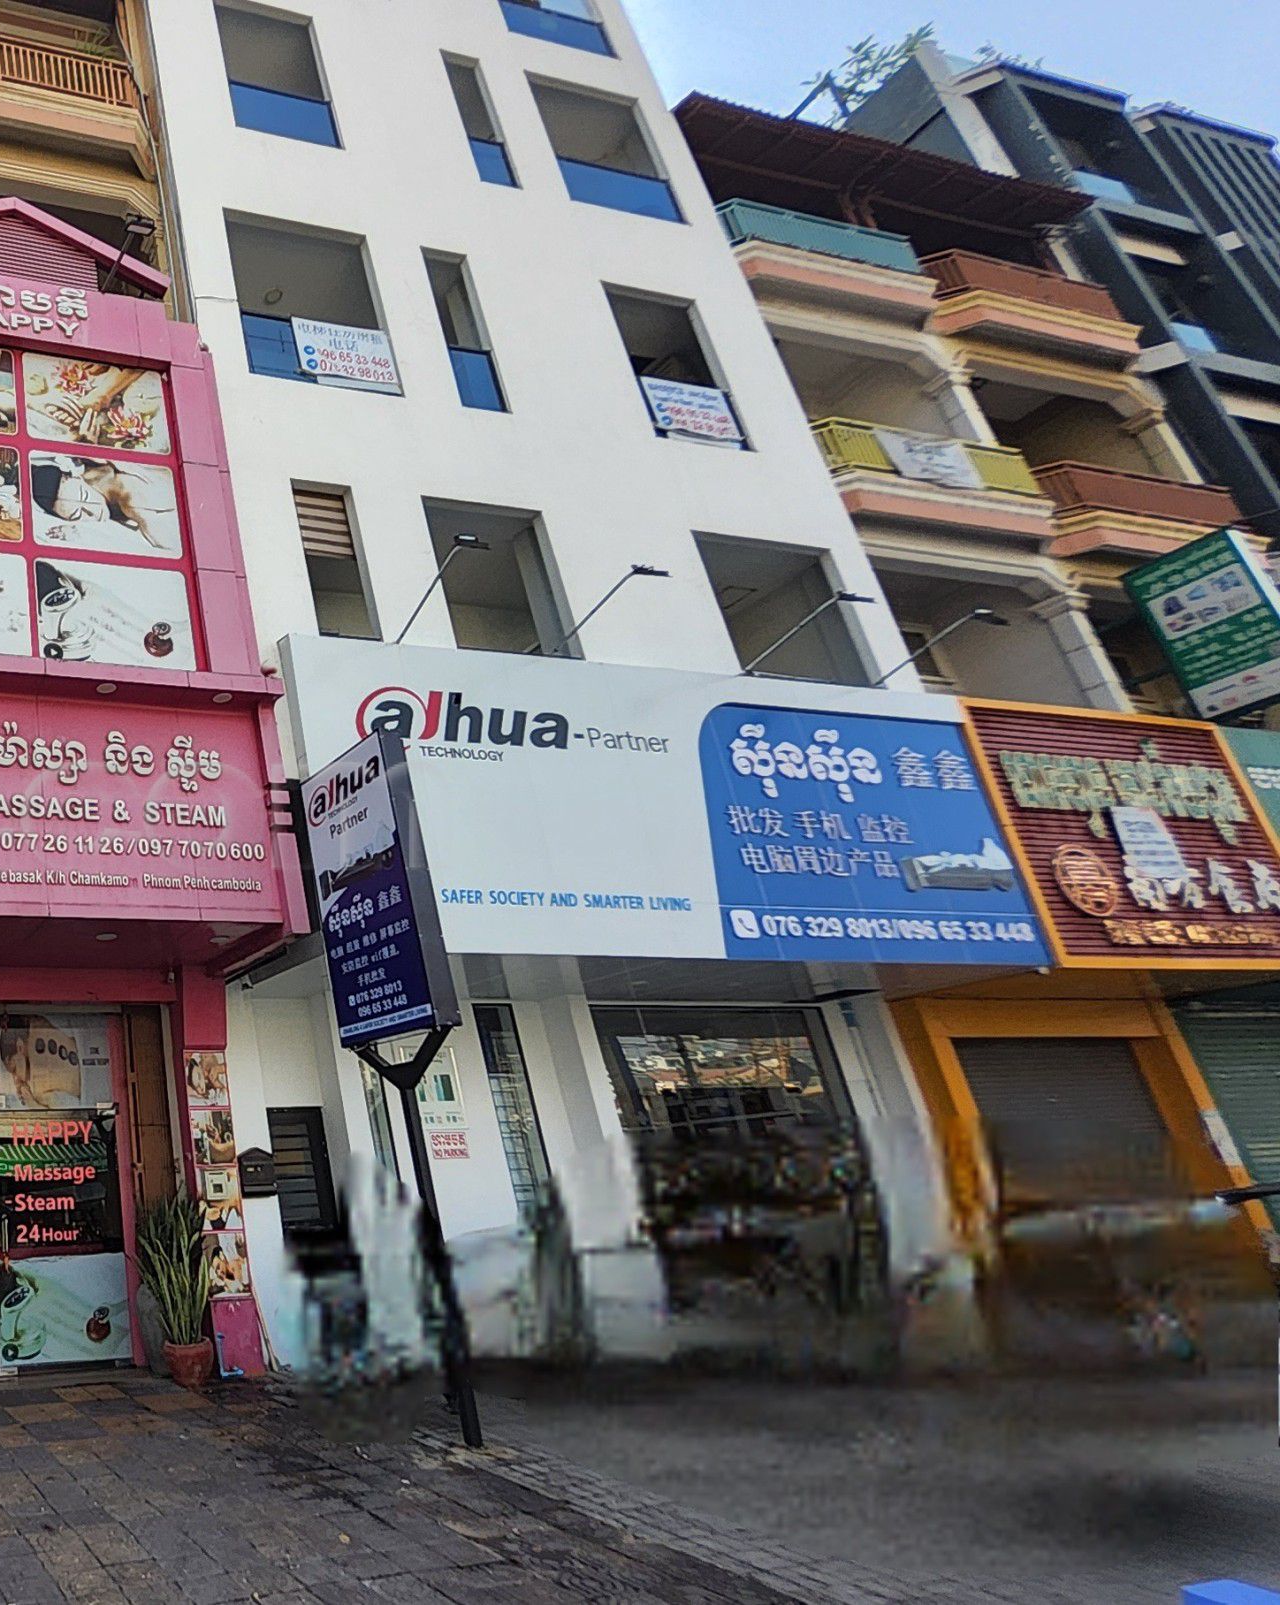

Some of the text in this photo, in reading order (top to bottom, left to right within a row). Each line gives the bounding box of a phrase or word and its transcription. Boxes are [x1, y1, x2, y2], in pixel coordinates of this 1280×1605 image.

[105, 730, 155, 776] និង
[418, 744, 505, 763] TECHNOLOGY
[891, 746, 978, 790] 鑫鑫
[113, 799, 132, 824] &
[144, 801, 227, 827] STEAM
[330, 806, 369, 840] Partner
[726, 804, 915, 845] 批发 手机 监控
[43, 833, 68, 853] 26
[73, 835, 95, 854] 11
[739, 842, 902, 879] 电脑周边产品
[9, 869, 42, 885] basak
[143, 873, 181, 889] Phnom
[183, 874, 210, 890] Penh
[441, 888, 692, 912] SAFER SOCIETY AND SMARTER LIVING
[762, 914, 804, 938] 076
[803, 915, 844, 939] 329
[11, 1120, 93, 1147] HAPPY
